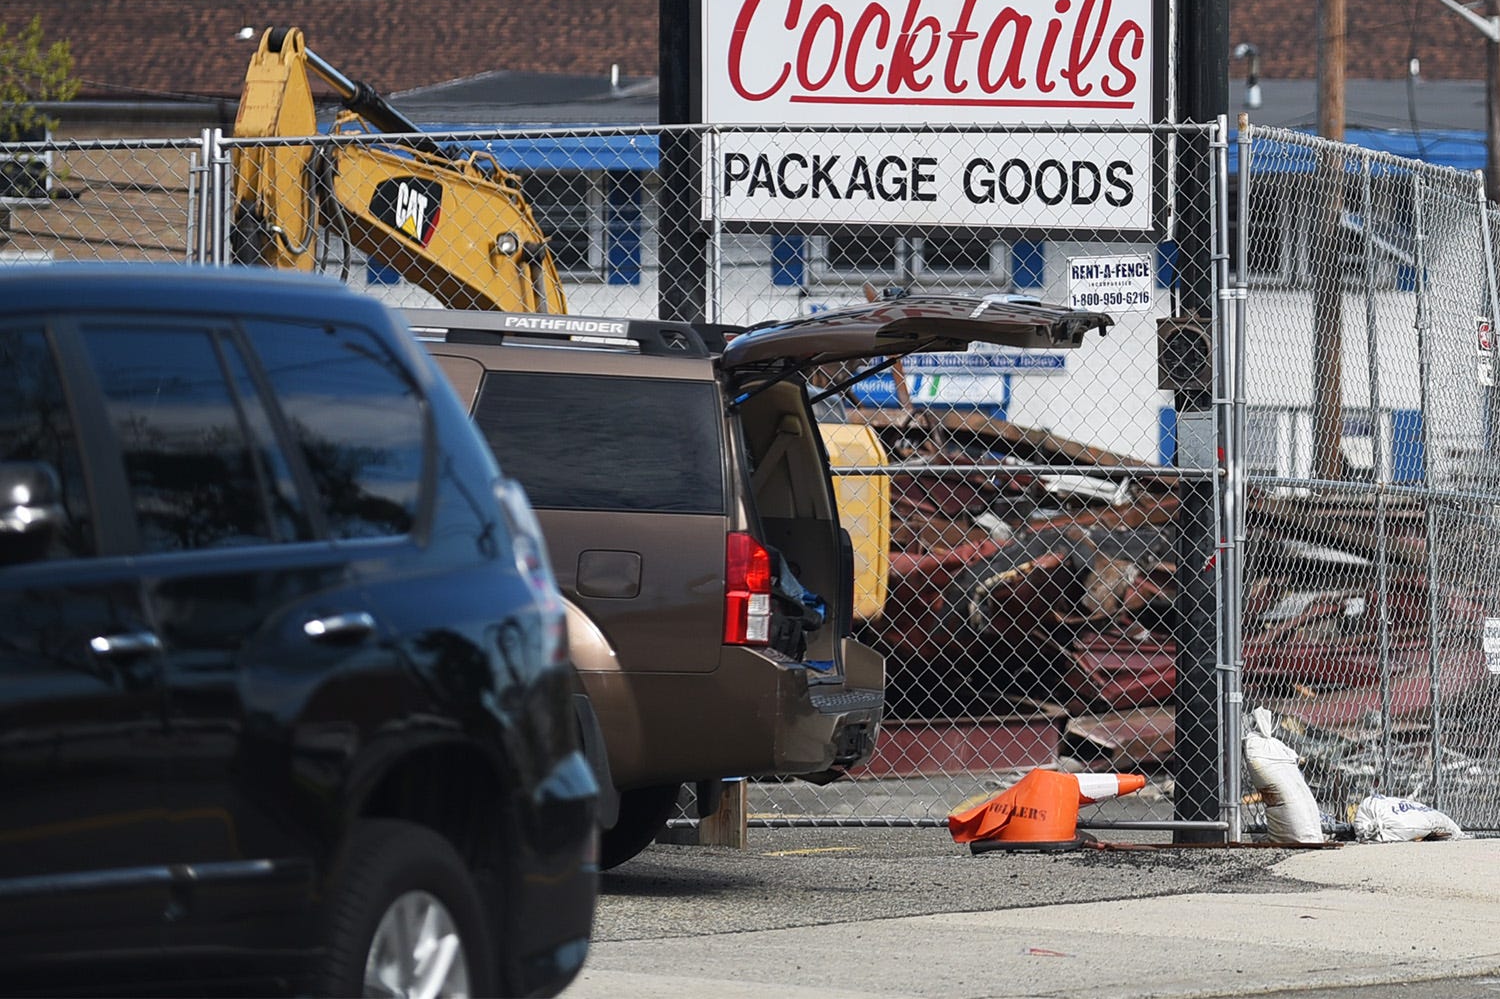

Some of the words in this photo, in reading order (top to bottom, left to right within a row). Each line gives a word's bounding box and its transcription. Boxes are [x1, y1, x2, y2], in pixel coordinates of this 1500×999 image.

[723, 152, 938, 202] PACKAGE
[962, 157, 1135, 208] GOODS
[395, 181, 428, 242] CAT
[1071, 262, 1150, 280] RENT-A-FENCE
[1071, 290, 1150, 307] 1-800-950-6216
[504, 316, 625, 334] PATHFINDER
